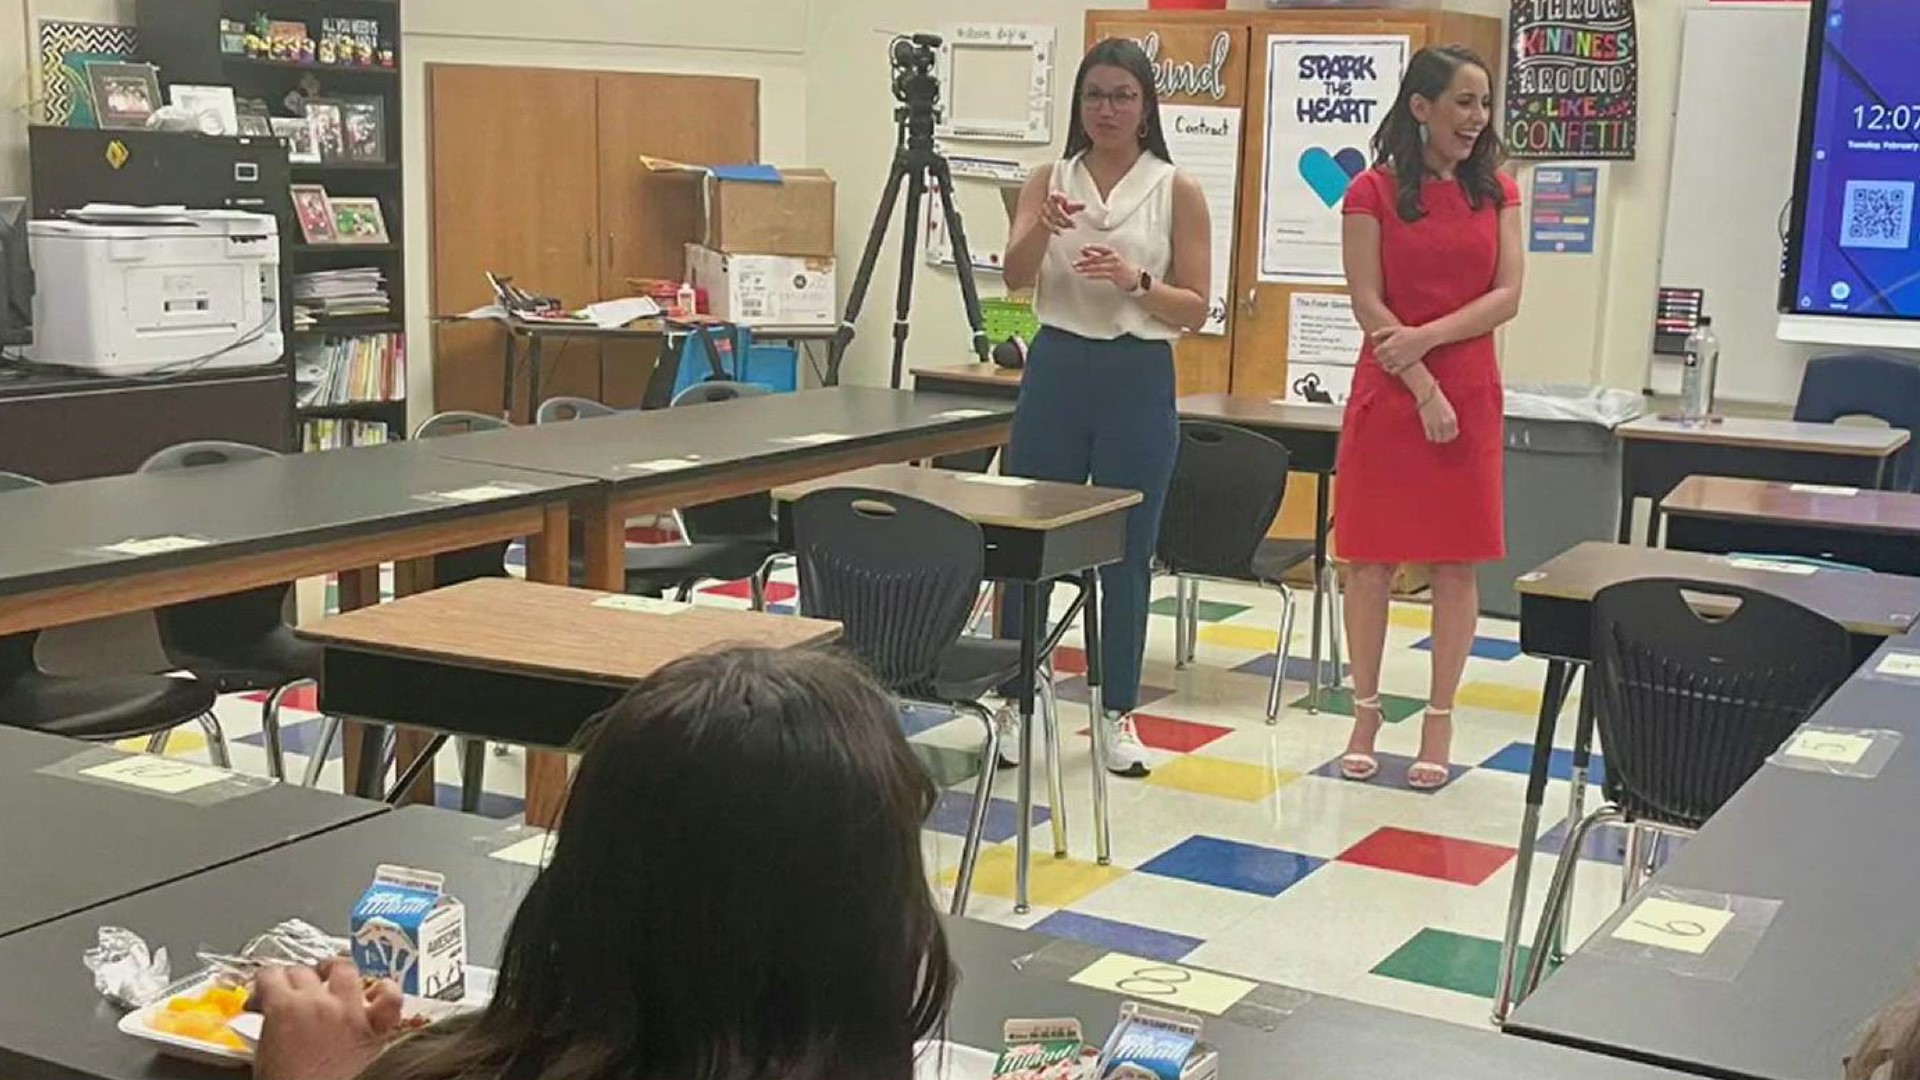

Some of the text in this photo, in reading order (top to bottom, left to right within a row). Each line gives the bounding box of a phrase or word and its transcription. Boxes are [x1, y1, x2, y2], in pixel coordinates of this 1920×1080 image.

[1532, 0, 1620, 20] THROW
[1523, 26, 1629, 60] KINDNESS
[1299, 55, 1377, 81] SPARK
[1519, 66, 1626, 94] AROUND
[1324, 81, 1353, 97] THE
[1296, 98, 1377, 124] HEART
[1546, 97, 1597, 118] LIKE
[1174, 115, 1230, 136] Contract
[1511, 120, 1629, 150] CONFETTI
[1115, 966, 1191, 995] 8
